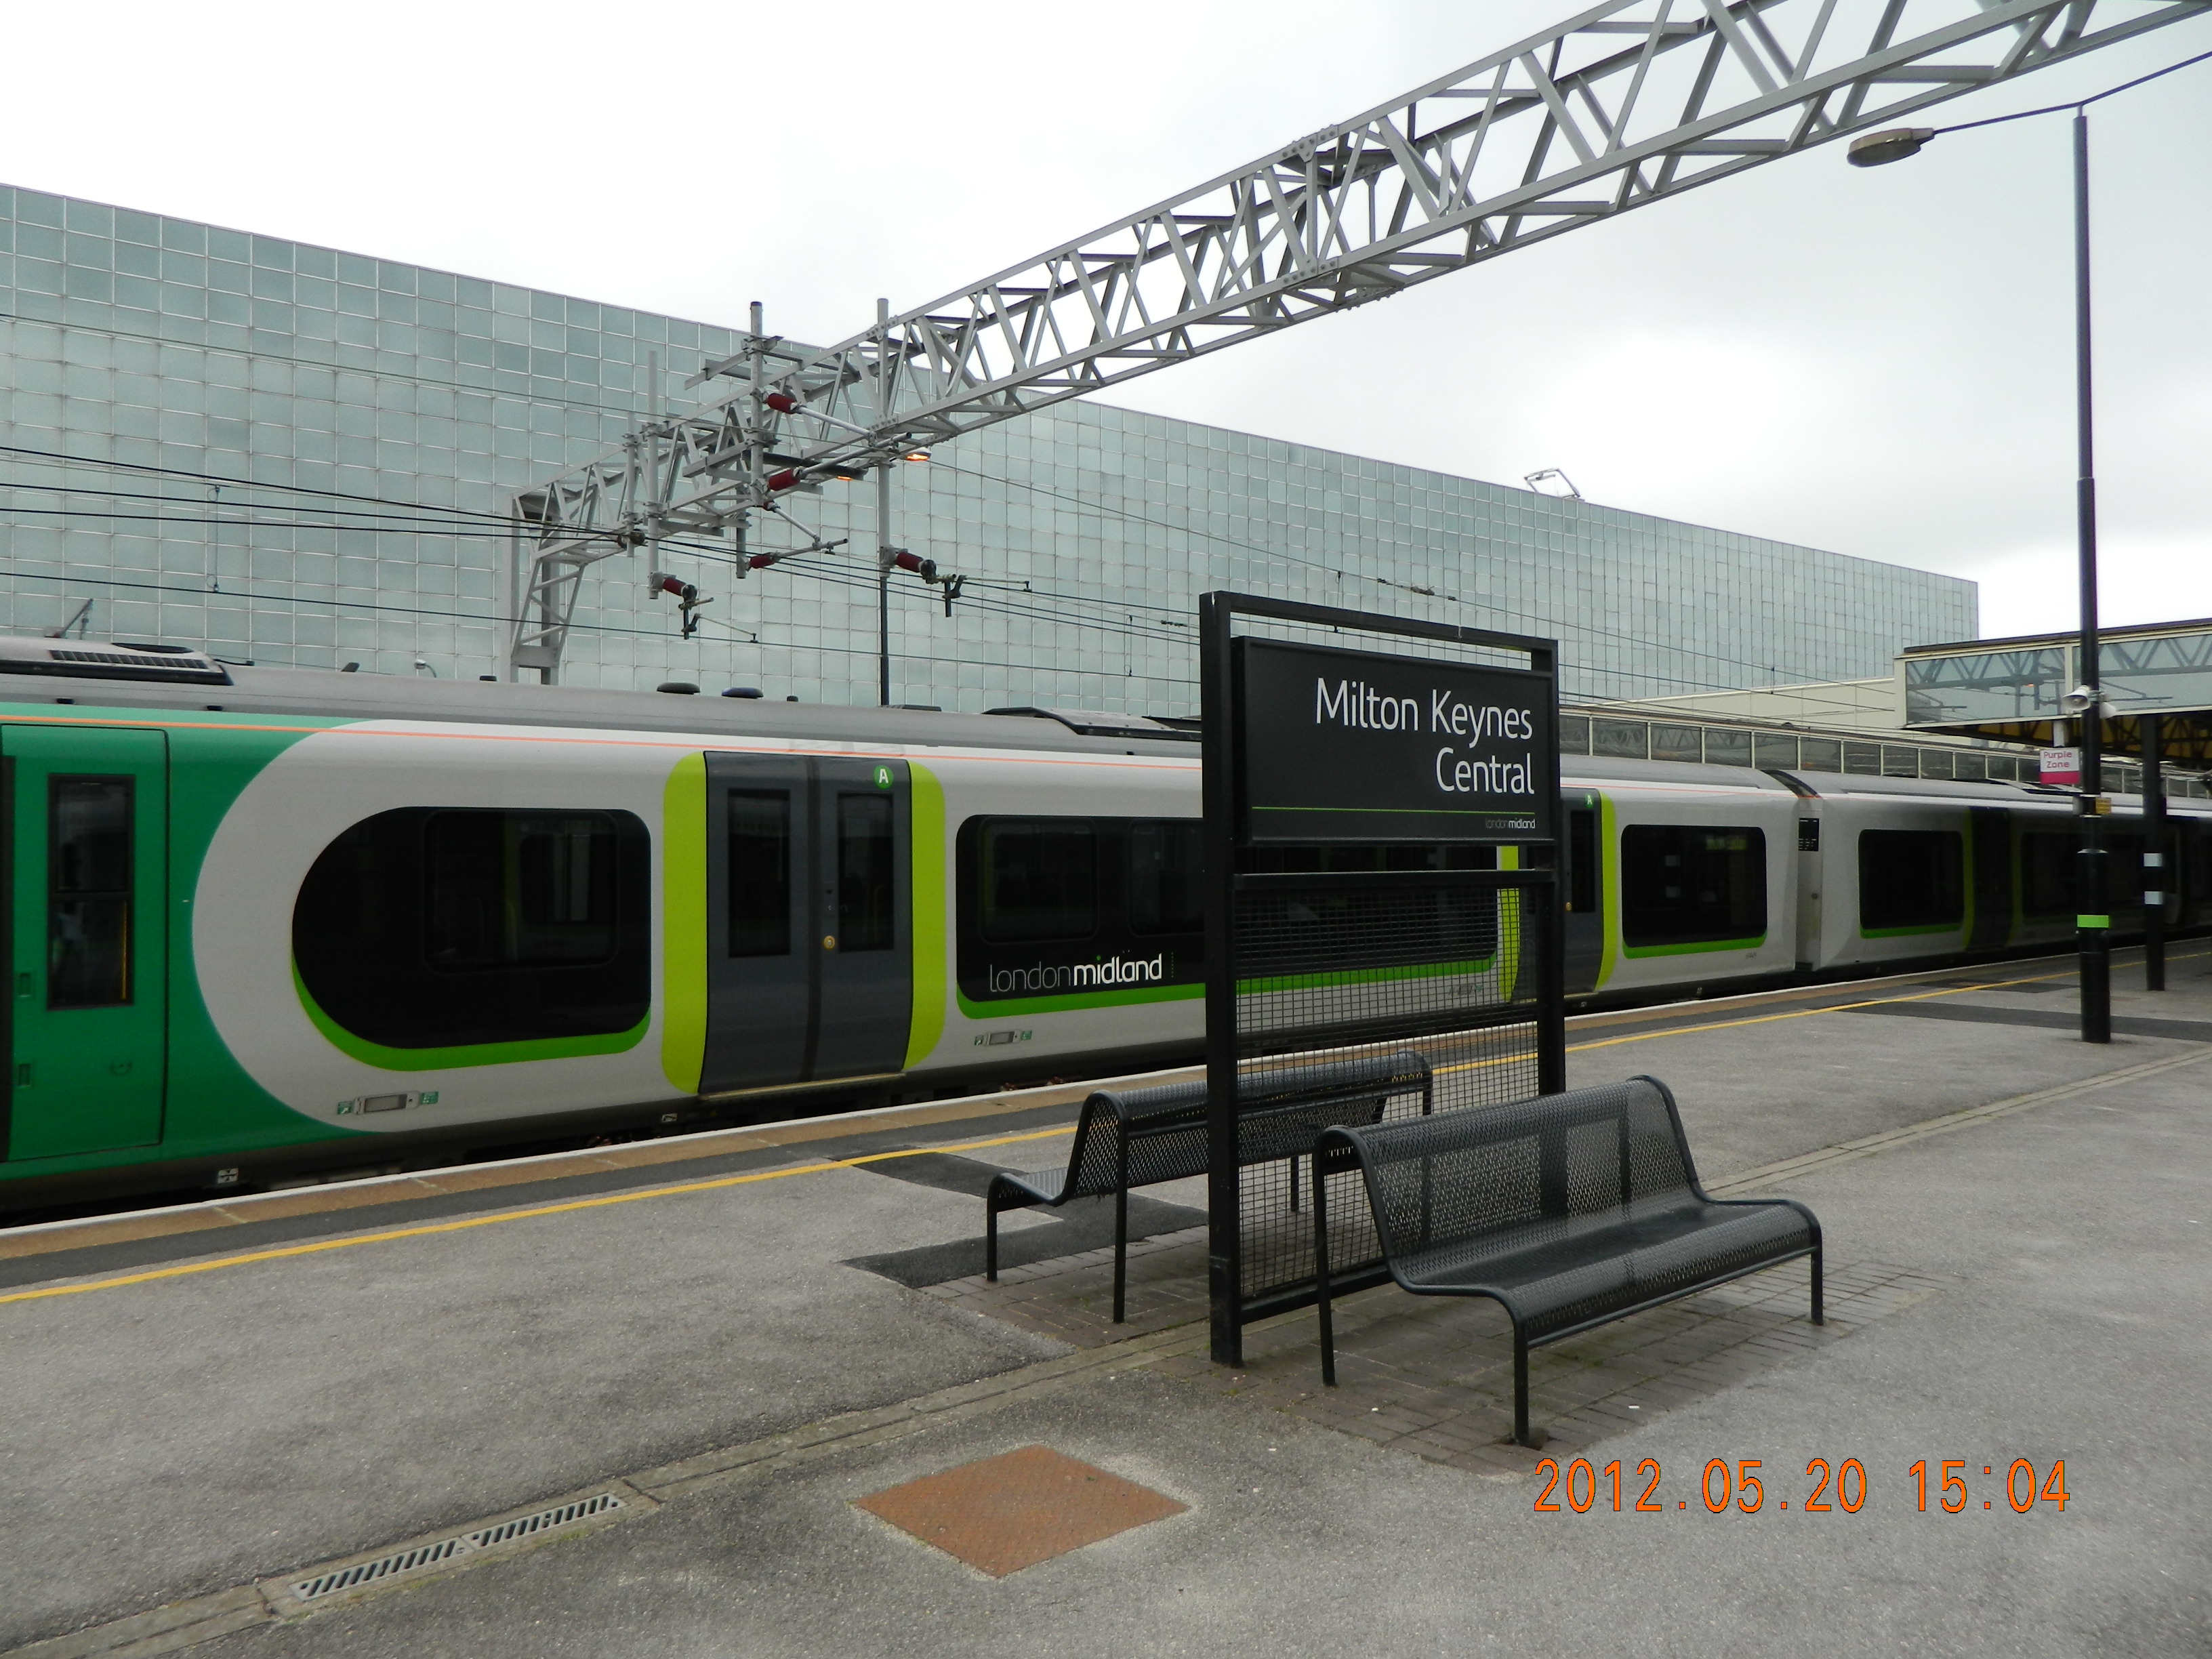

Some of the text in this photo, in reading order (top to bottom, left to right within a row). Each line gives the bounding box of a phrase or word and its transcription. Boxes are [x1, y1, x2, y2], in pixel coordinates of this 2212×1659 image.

[1316, 677, 1533, 748] Milton Keynes
[2043, 751, 2072, 759] Purple
[879, 769, 889, 783] A
[1436, 747, 1534, 795] Central
